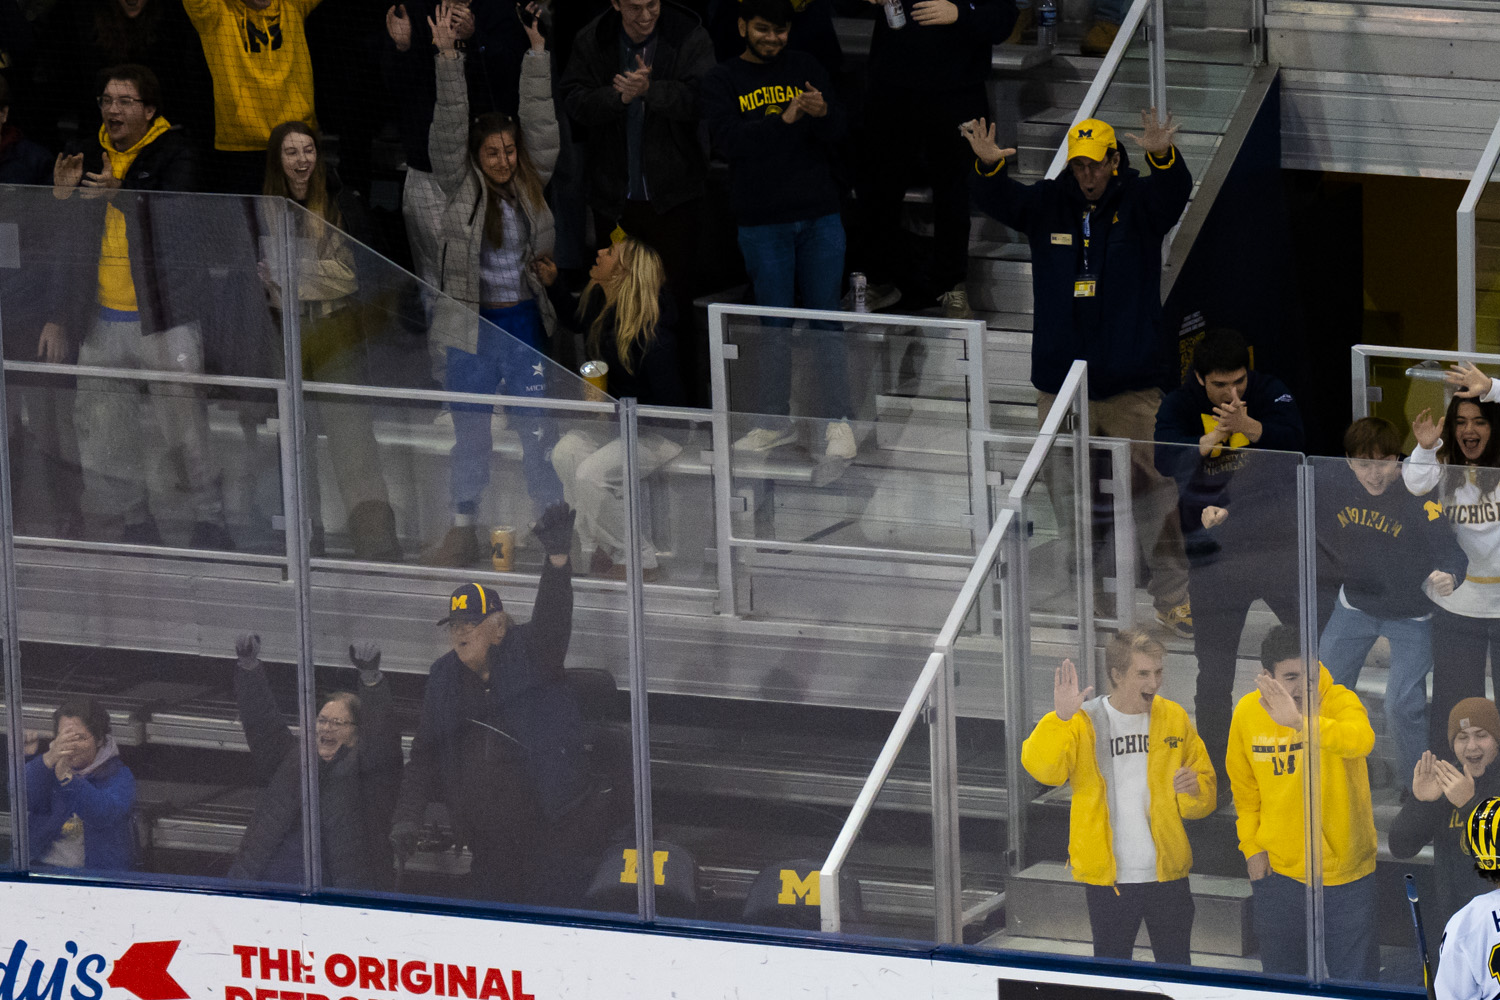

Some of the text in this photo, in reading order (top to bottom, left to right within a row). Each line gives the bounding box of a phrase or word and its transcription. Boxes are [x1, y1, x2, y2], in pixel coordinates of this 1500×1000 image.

[452, 595, 468, 611] M
[778, 869, 821, 906] M
[233, 944, 316, 985] THE
